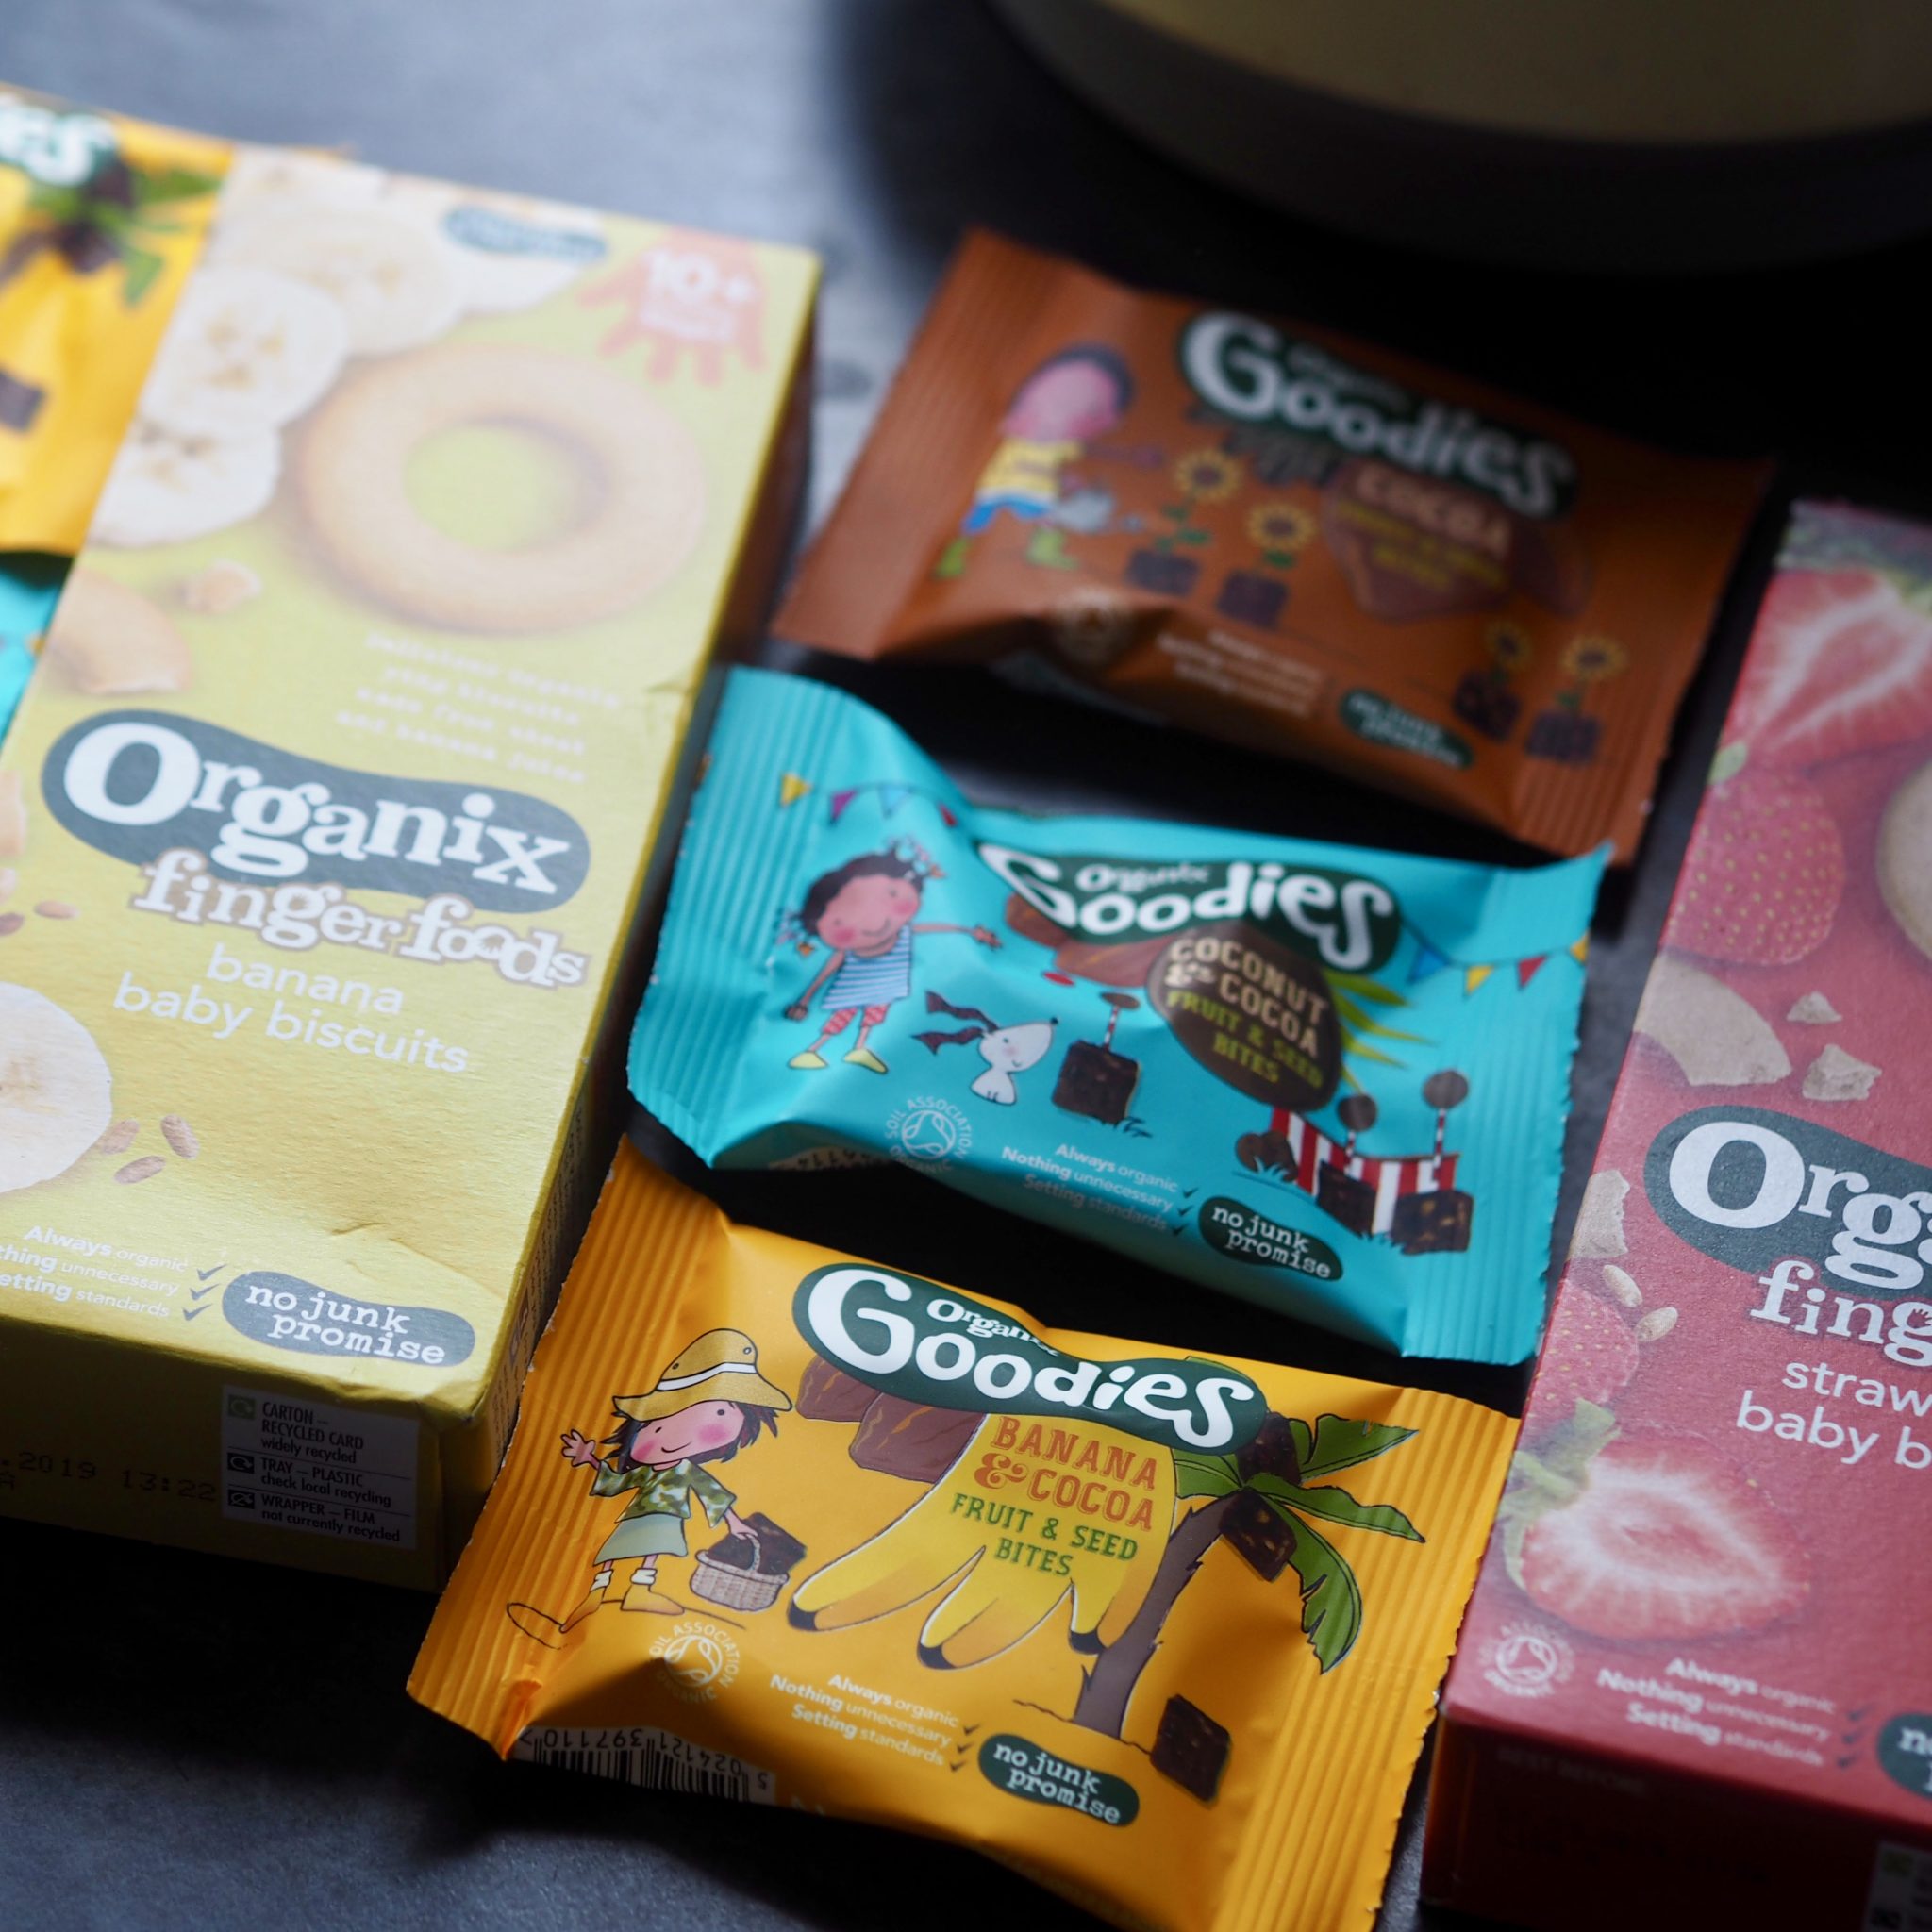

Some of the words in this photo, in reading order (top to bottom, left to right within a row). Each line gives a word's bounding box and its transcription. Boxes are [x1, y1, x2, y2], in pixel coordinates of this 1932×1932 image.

[1183, 312, 1576, 518] Goodies
[64, 722, 570, 896] Organix
[978, 843, 1395, 970] Goodies
[207, 943, 404, 1015] banana
[1170, 937, 1327, 1025] COCONUT
[112, 970, 253, 1039] baby
[265, 998, 469, 1073] biscuits
[1166, 991, 1241, 1032] FRUIT
[1220, 973, 1318, 1058] COCOA
[1213, 1032, 1279, 1083] BITES
[885, 1109, 908, 1139] SOIL
[907, 1095, 973, 1159] ASSOCIATION
[1002, 1146, 1072, 1179] Nothing
[1074, 1170, 1173, 1212] unnecessary
[1055, 1144, 1117, 1174] Always
[1118, 1164, 1178, 1193] organic
[1024, 1174, 1084, 1209] Setting
[1087, 1194, 1168, 1231] standards
[1669, 1121, 1932, 1290] Org
[25, 1225, 112, 1257] Always
[116, 1249, 189, 1273] organic
[1212, 1206, 1243, 1228] no
[1245, 1215, 1309, 1254] junk
[1225, 1227, 1331, 1278] promise
[60, 1260, 180, 1297] unnecessary
[76, 1288, 172, 1318] standards
[245, 1283, 296, 1312] no
[308, 1290, 411, 1334] junk
[268, 1311, 445, 1366] promise
[808, 1268, 1255, 1449] Goodies
[262, 1402, 314, 1425] CARTON
[262, 1420, 325, 1443] RECYCLED
[329, 1431, 364, 1450] CARD
[1736, 1389, 1880, 1465] baby
[260, 1437, 302, 1457] widely
[305, 1446, 357, 1464] recycled
[261, 1457, 292, 1474] TRAY
[312, 1466, 363, 1487] PLASTIC
[993, 1416, 1158, 1491] BANANA
[122, 1469, 216, 1503] 13:22
[261, 1474, 297, 1491] check
[301, 1480, 331, 1496] local
[335, 1487, 391, 1507] recycling
[261, 1493, 325, 1516] WRAPPER
[344, 1508, 375, 1524] FILM
[974, 1452, 1028, 1490] &
[1027, 1468, 1153, 1532] COCOA
[262, 1509, 282, 1522] not
[287, 1513, 343, 1534] currently
[348, 1525, 400, 1541] recycled
[951, 1492, 1034, 1535] FRUIT
[1041, 1518, 1059, 1541] &
[1072, 1524, 1139, 1562] SEED
[995, 1537, 1074, 1577] BITES
[673, 1621, 740, 1689] ASSOCIATION
[1665, 1657, 1758, 1696] Always
[770, 1674, 843, 1712] Nothing
[845, 1701, 952, 1749] unnecessary
[828, 1674, 891, 1706] Always
[894, 1697, 959, 1728] organic
[1596, 1668, 1703, 1714] Nothing
[791, 1704, 858, 1739] Setting
[859, 1724, 944, 1767] standards
[1626, 1702, 1721, 1745] Setting
[993, 1740, 1028, 1766] no
[1029, 1752, 1102, 1793] junk
[1006, 1768, 1121, 1824] promise
